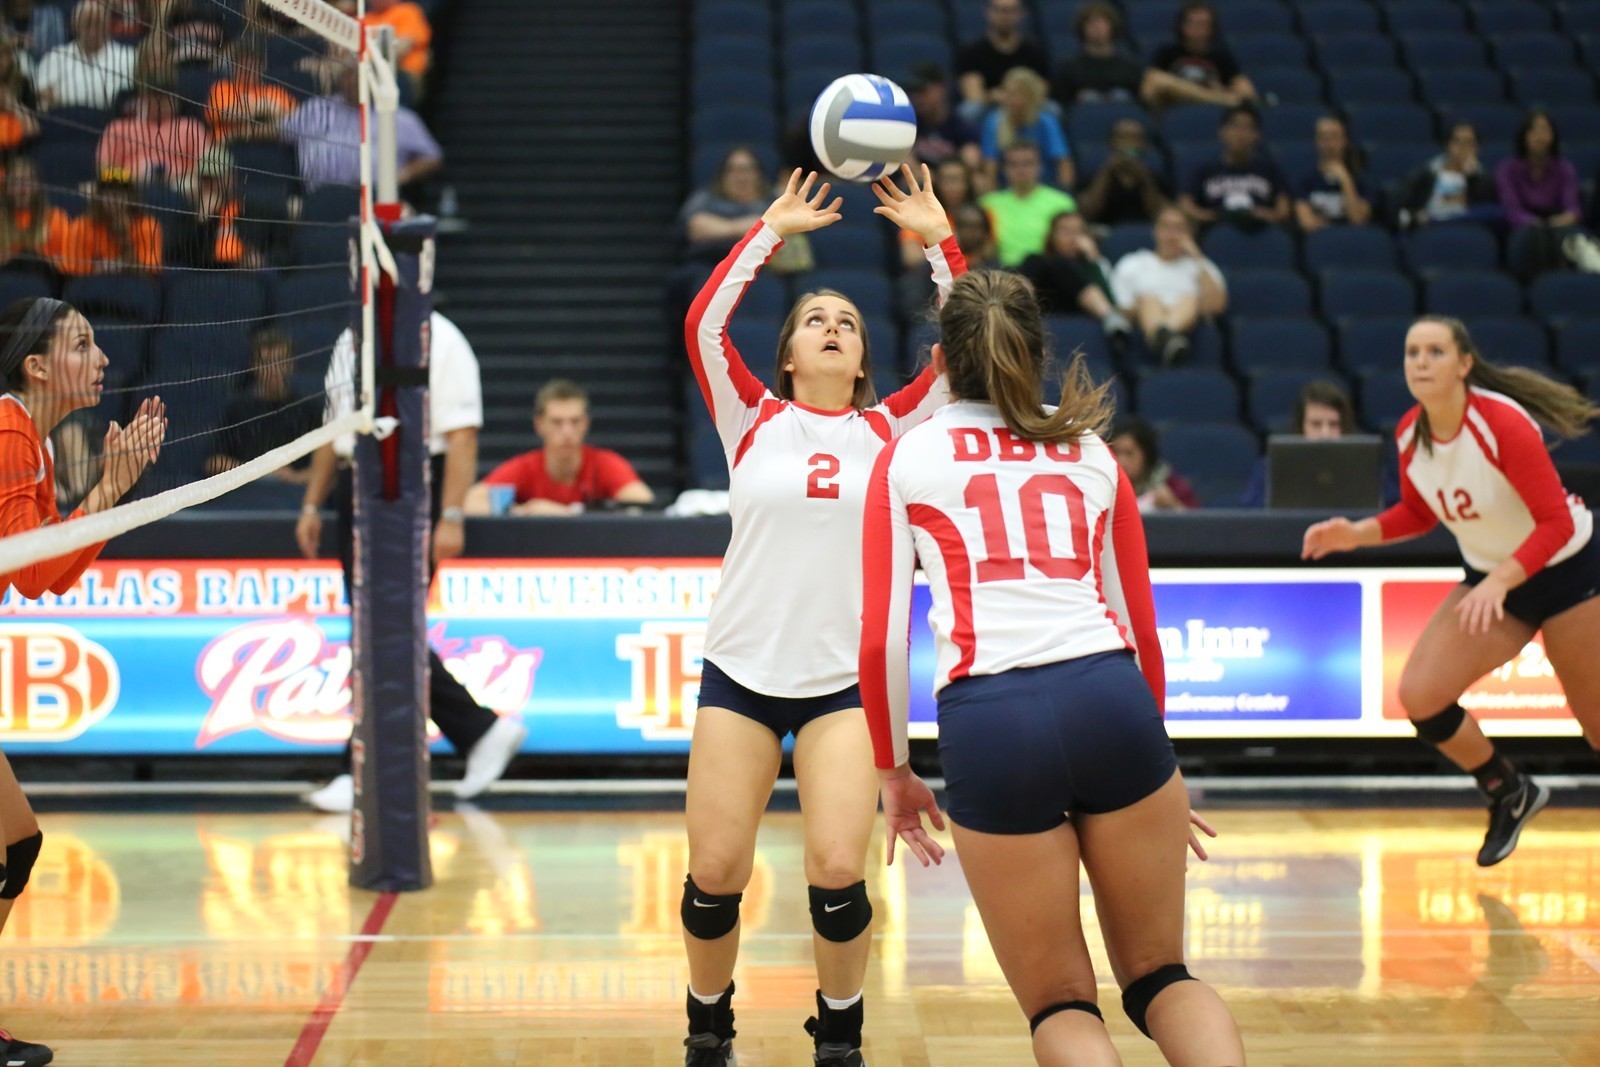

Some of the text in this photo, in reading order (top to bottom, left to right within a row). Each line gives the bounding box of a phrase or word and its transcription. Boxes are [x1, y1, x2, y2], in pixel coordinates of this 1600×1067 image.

[806, 453, 840, 499] 2
[1437, 488, 1481, 521] 12
[964, 473, 1092, 583] 10
[0, 571, 181, 610] LLAS
[443, 570, 719, 609] UNIVERSIT
[1187, 620, 1264, 658] Inn
